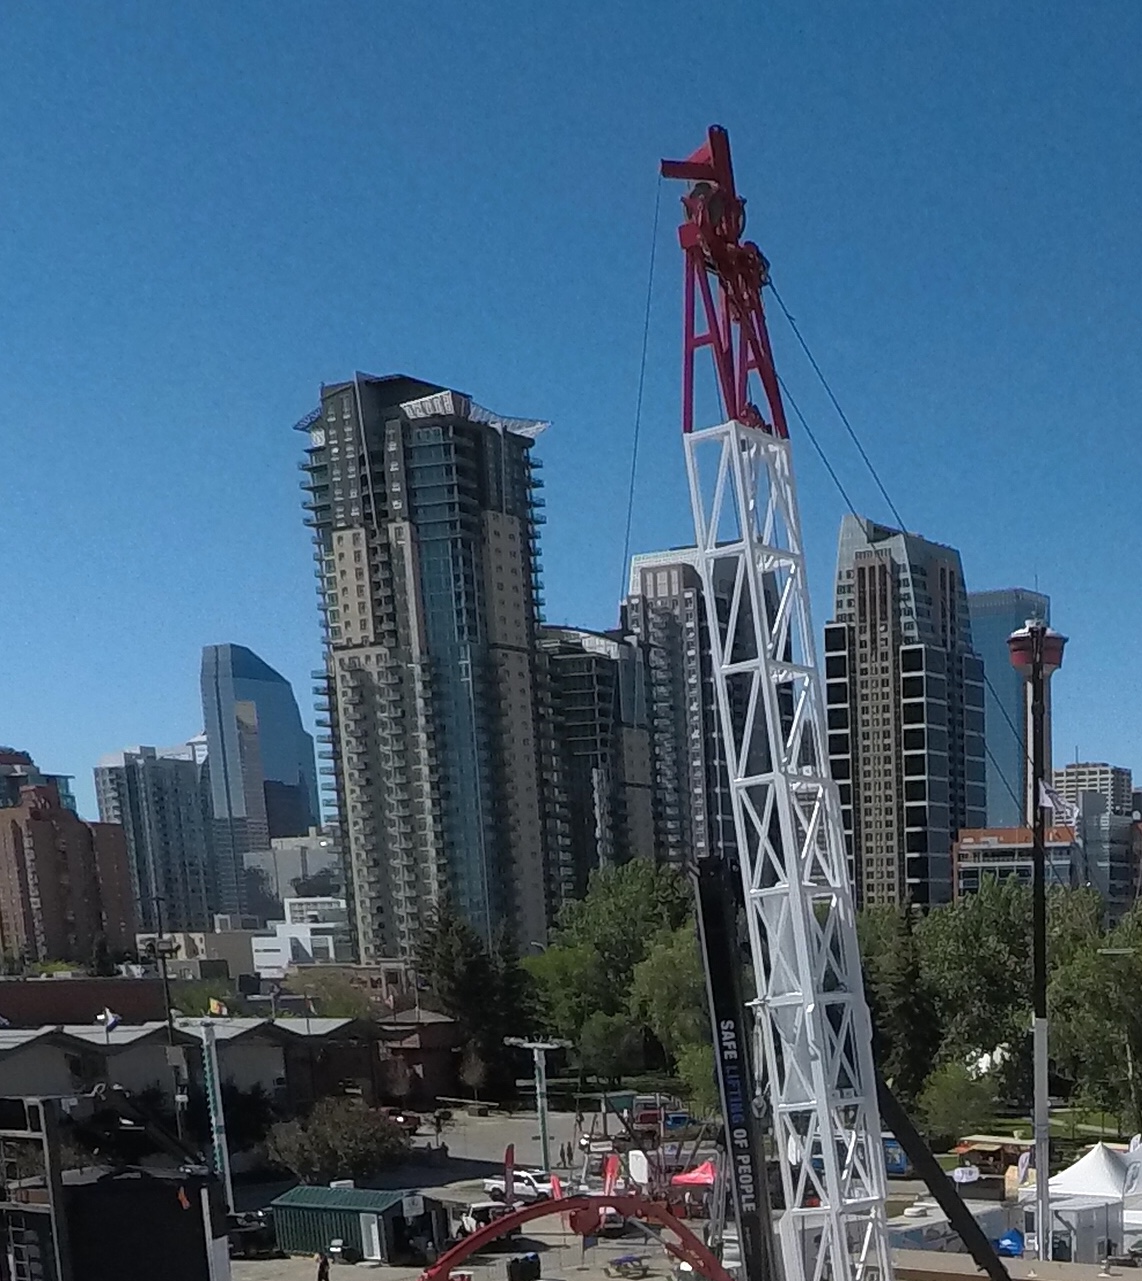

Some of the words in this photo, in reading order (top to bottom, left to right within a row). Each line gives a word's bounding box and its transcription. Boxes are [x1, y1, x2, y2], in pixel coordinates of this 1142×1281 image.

[720, 1019, 738, 1060] SAFE
[725, 1065, 745, 1125] LIFTING
[733, 1127, 749, 1149] OF
[736, 1154, 757, 1213] PEOPLE
